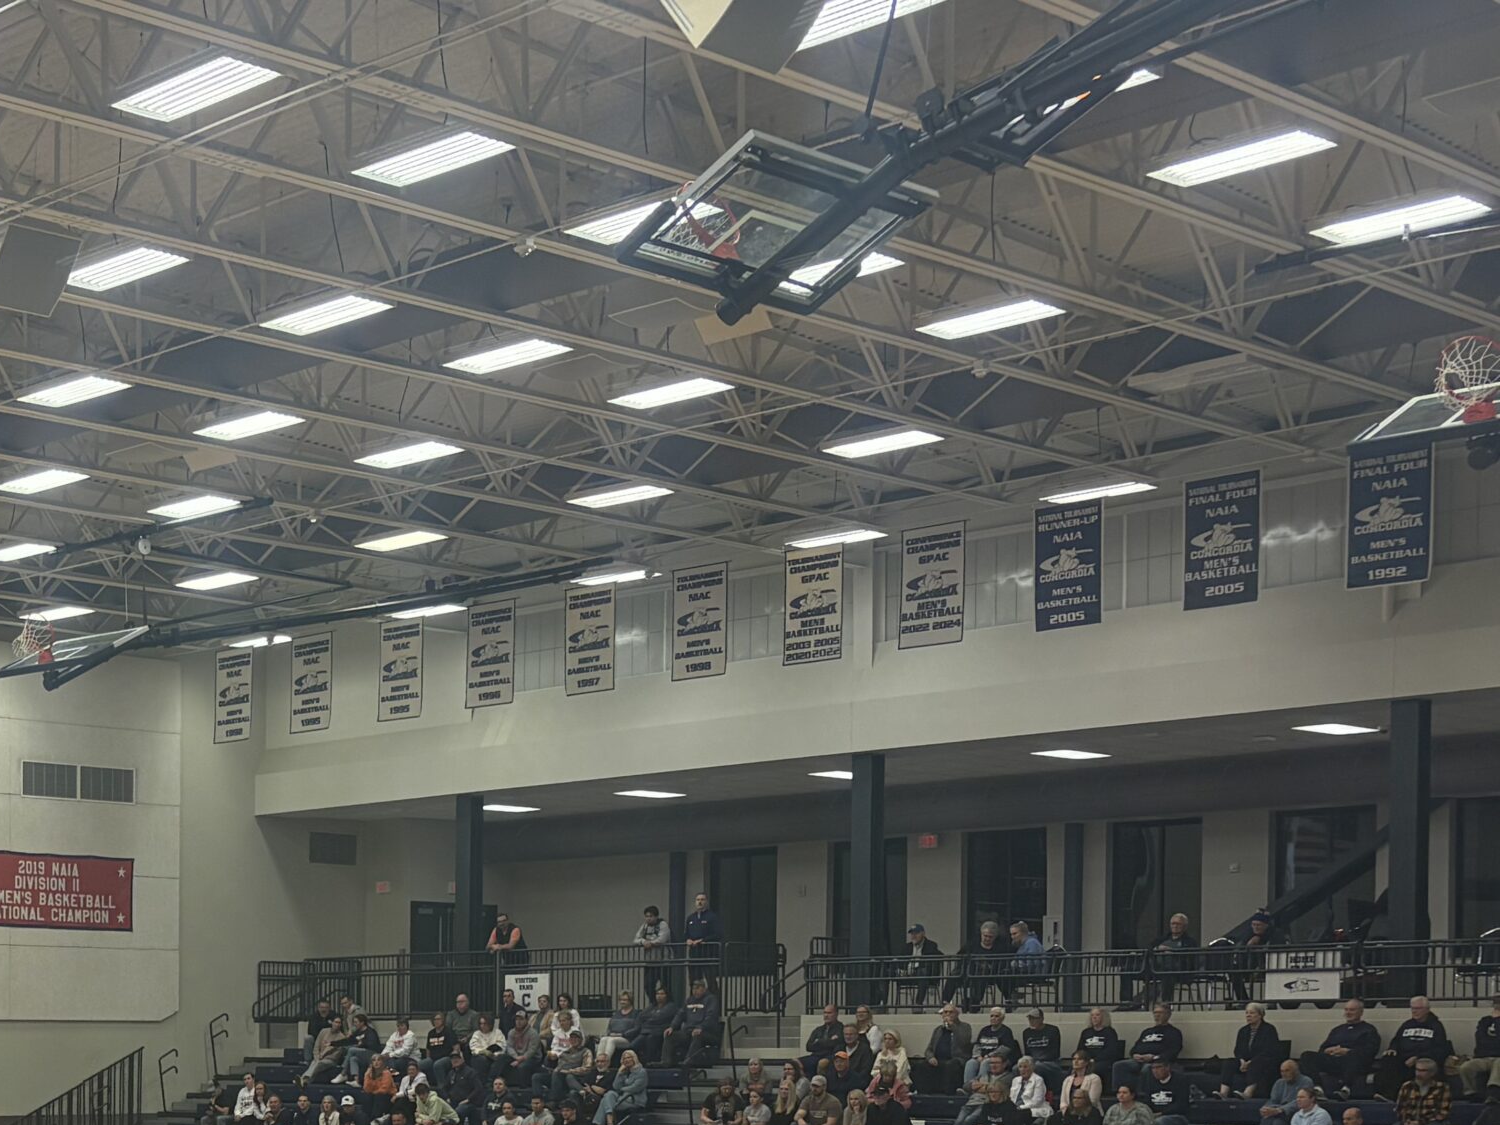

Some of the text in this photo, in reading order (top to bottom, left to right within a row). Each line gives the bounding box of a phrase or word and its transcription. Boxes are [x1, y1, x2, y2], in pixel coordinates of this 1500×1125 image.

[1353, 458, 1428, 479] FINAL FOUR
[1371, 477, 1408, 491] NAIA
[1188, 493, 1222, 507] FINAL
[1226, 487, 1257, 500] FOUR
[1205, 504, 1239, 518] NAIA
[1038, 515, 1099, 532] RUNNER-UP
[1354, 517, 1424, 536] CONCORDIA
[1053, 531, 1082, 544] NAIA
[1369, 537, 1406, 550] MEN'S
[918, 552, 950, 565] GPAC
[1190, 542, 1253, 560] CONCORDIA
[1351, 547, 1426, 565] BASKETBALL
[1203, 556, 1240, 570] MEN'S
[801, 571, 830, 584] GPAC
[1039, 567, 1096, 584] CONCORDIA
[1185, 563, 1258, 582] BASKETBALL
[1367, 566, 1407, 580] 1992
[1051, 585, 1083, 597] MEN'S
[1204, 582, 1245, 598] 2005
[916, 598, 947, 611] MEN'S
[1037, 594, 1099, 610] BASKETBALL
[901, 606, 963, 622] BASKETBALL
[1049, 610, 1085, 625] 2005
[786, 624, 841, 640] BASKETBALL
[901, 619, 962, 634] 2022 2024
[786, 636, 840, 652] 2003 2005
[675, 647, 723, 660] BASKETBALL
[786, 647, 840, 662] 2020 2022
[577, 677, 601, 688] 1997
[18, 860, 79, 877] 2019 NAIA
[15, 876, 80, 892] DIVISION II
[39, 892, 116, 909] BASKETBALL
[51, 908, 109, 923] CHAMPION
[522, 994, 531, 1007] C
